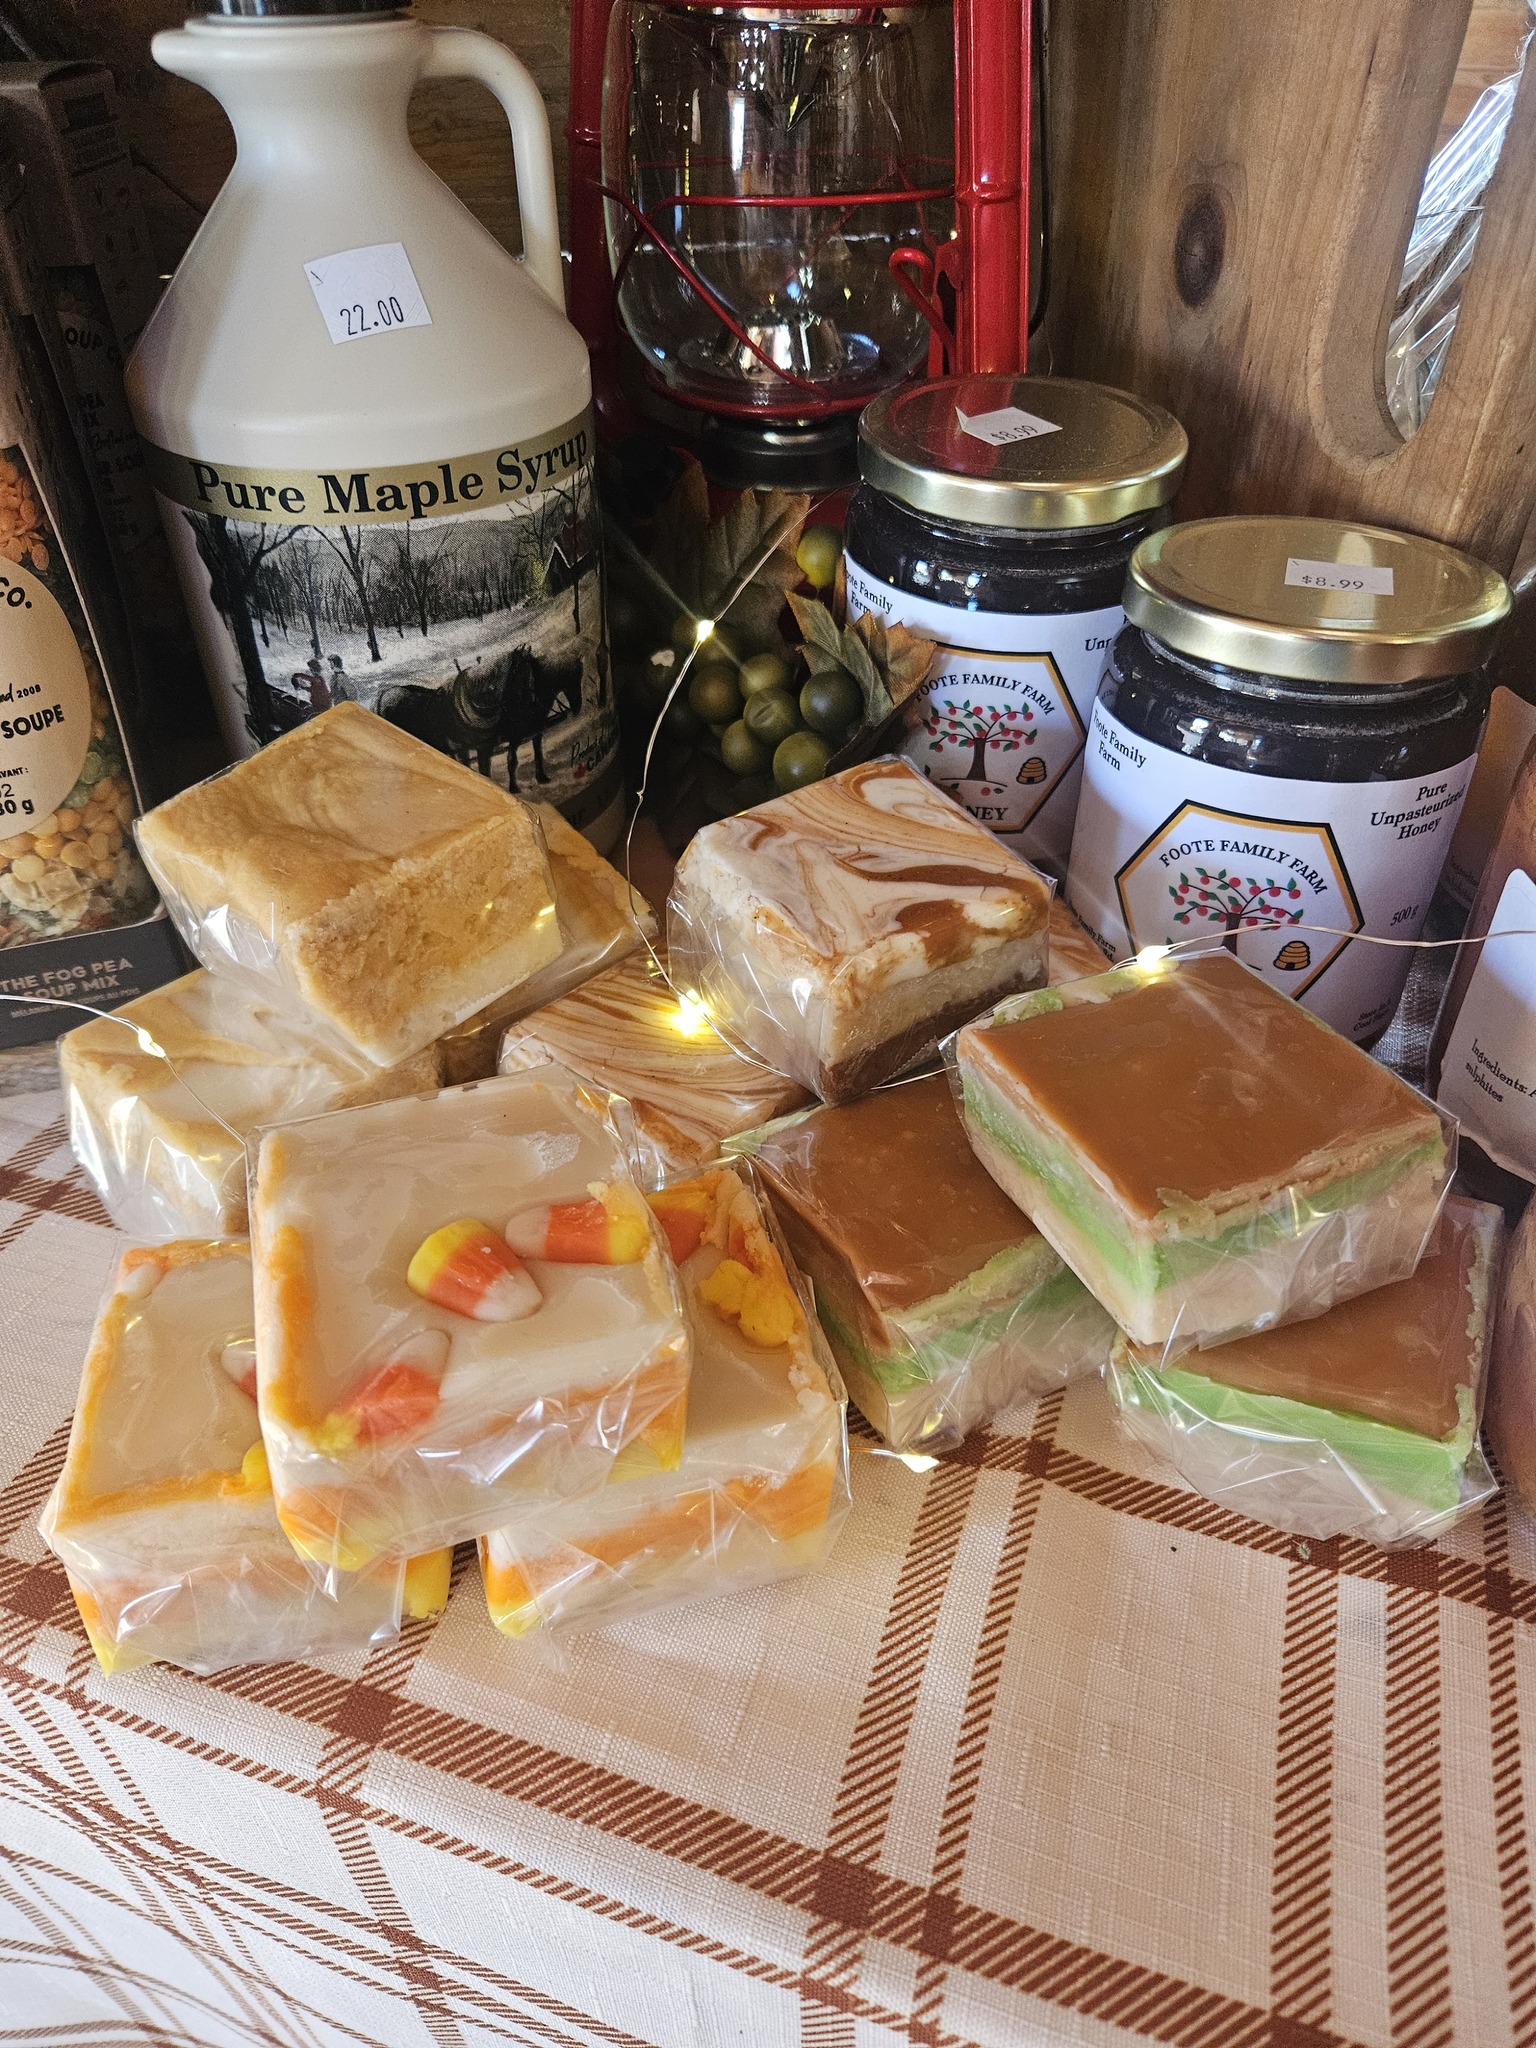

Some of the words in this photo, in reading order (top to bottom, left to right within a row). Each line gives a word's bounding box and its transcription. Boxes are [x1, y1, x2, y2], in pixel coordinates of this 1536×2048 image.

[340, 296, 404, 336] 22.00
[65, 328, 103, 351] OUP
[991, 425, 1038, 441] $8.99
[190, 461, 306, 514] Pure
[318, 464, 484, 519] Maple
[496, 429, 588, 495] Syrup
[860, 580, 893, 615] Family
[1301, 574, 1364, 590] $8.99
[16, 684, 42, 699] 2008
[962, 673, 1022, 691] FAMILY
[1021, 684, 1056, 717] FARM
[1, 704, 65, 739] SOUPE
[1093, 710, 1109, 739] Foote
[1109, 729, 1147, 769] Family
[1098, 740, 1121, 772] Farm
[22, 799, 35, 816] g
[1370, 784, 1466, 828] Unpasteurized
[1415, 783, 1447, 802] Pure
[966, 806, 1009, 821] NEY
[1397, 817, 1441, 840] Honey
[1159, 840, 1215, 867] FOOTE
[1220, 840, 1290, 864] FAMILY
[1288, 857, 1328, 895] FARM
[1390, 905, 1412, 926] 500
[0, 975, 39, 993] THE
[42, 966, 87, 984] FOG
[91, 958, 134, 975] PEA
[23, 983, 76, 999] SOUP
[82, 974, 120, 992] MIX
[1465, 1062, 1504, 1103] sulphites
[1472, 1038, 1528, 1094] Ingredients:
